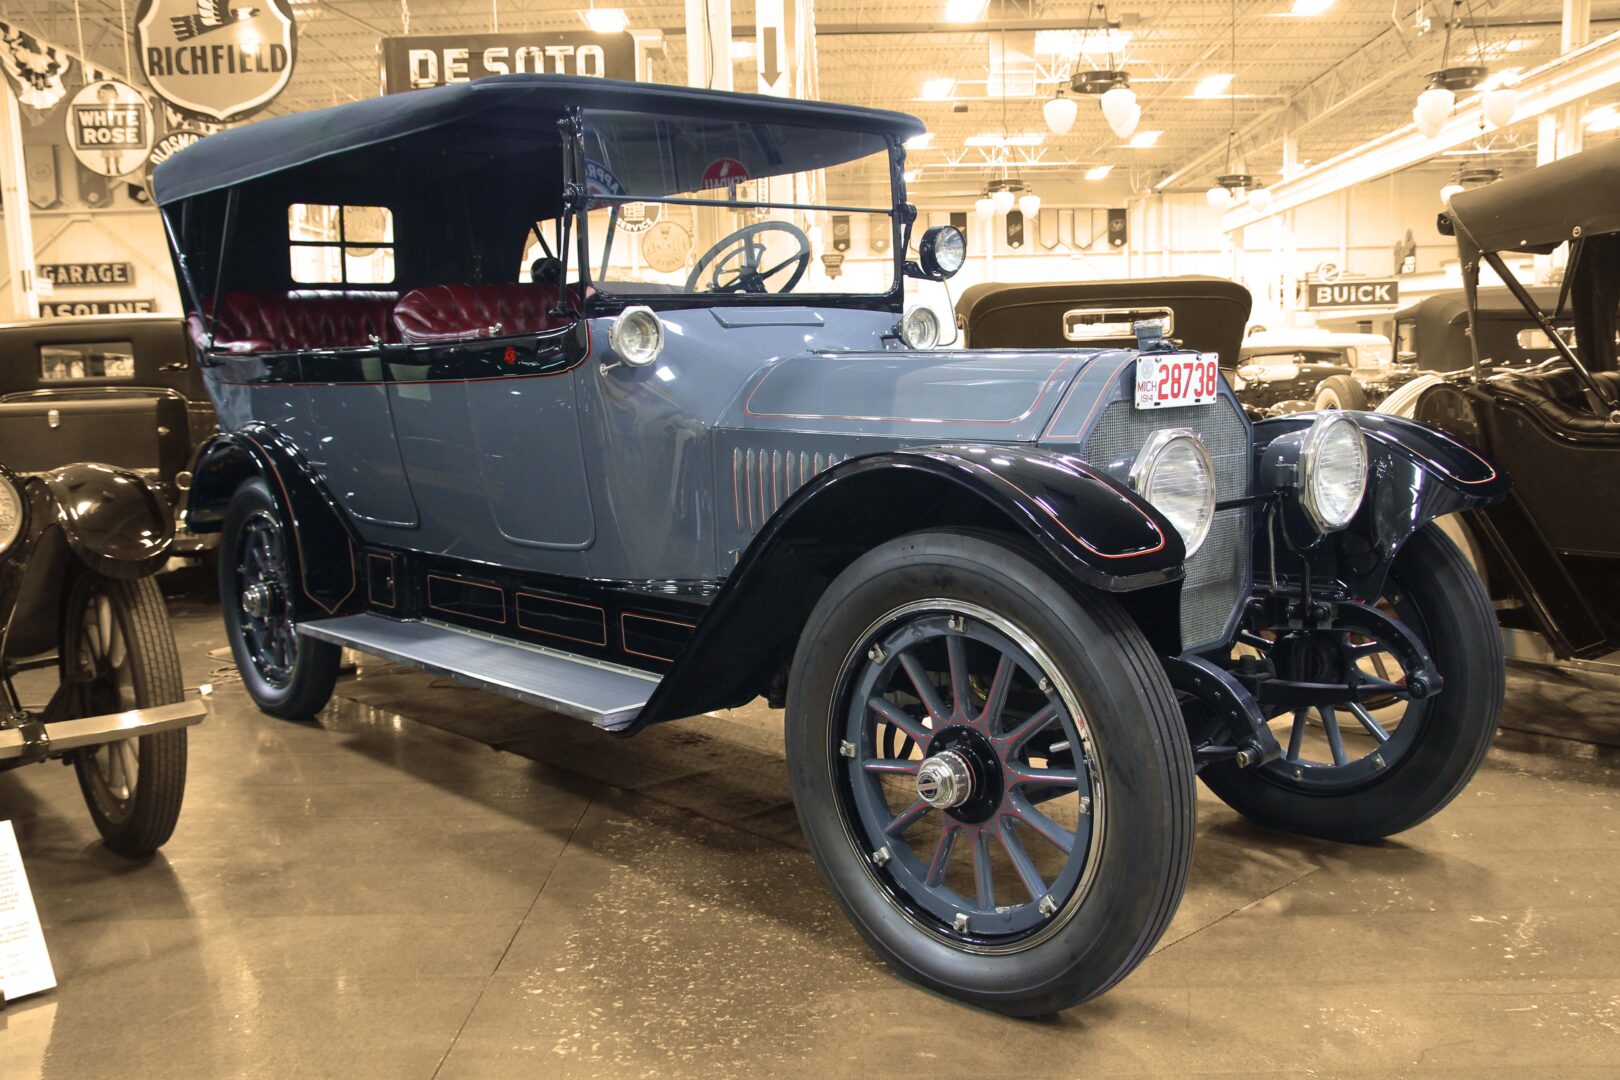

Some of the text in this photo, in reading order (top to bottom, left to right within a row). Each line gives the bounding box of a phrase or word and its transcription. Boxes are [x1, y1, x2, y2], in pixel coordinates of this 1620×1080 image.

[147, 43, 288, 77] RICHFIELD
[408, 44, 605, 88] DE SOTO
[78, 110, 139, 127] WHITE
[83, 127, 139, 144] ROSE
[616, 217, 653, 232] SERVICE
[42, 263, 126, 284] GARAGE
[1316, 284, 1391, 304] BUICK
[1137, 381, 1157, 392] MICH
[1157, 361, 1217, 401] 28738
[1140, 394, 1154, 403] 1914
